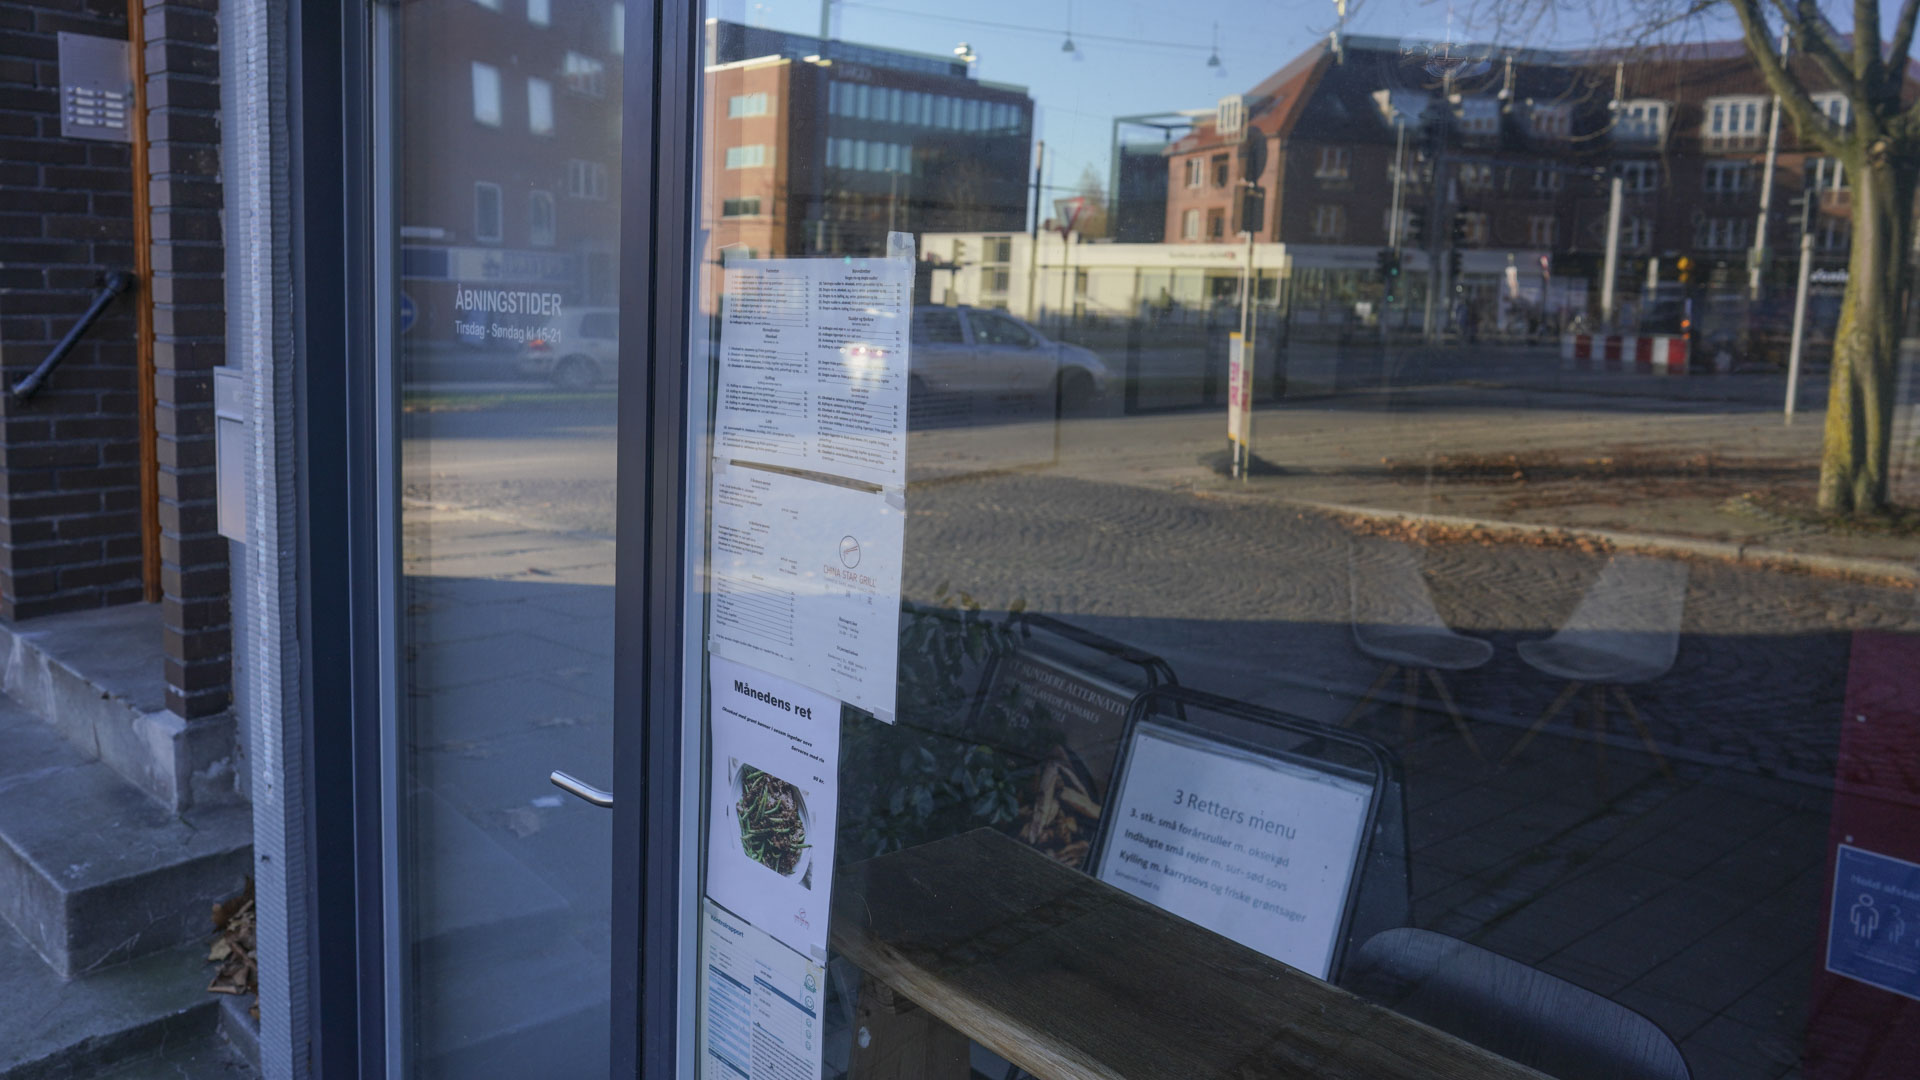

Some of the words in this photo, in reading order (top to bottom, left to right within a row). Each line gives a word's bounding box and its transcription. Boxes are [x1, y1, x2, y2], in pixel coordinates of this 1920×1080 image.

[455, 283, 562, 316] ÅBNINGSTIDER
[455, 320, 485, 340] Tirsdag
[491, 323, 524, 343] Søndag
[526, 326, 534, 339] kl
[536, 327, 561, 343] 15-21
[823, 564, 841, 577] CHINA
[842, 570, 858, 582] STAR
[859, 574, 876, 588] GRILL
[734, 680, 791, 712] Månedens
[794, 704, 812, 720] ret
[1173, 789, 1184, 805] 3
[1187, 793, 1245, 824] Retters
[1248, 815, 1296, 840] menu
[1129, 808, 1138, 818] 3.
[1140, 813, 1156, 824] stk.
[1158, 818, 1176, 830] små
[1178, 823, 1232, 849] forårsruller
[1234, 843, 1246, 854] m.
[1248, 848, 1290, 867] oksekød
[1124, 829, 1163, 850] Indbagte
[1165, 844, 1184, 856] små
[1186, 850, 1210, 864] rejer
[1211, 859, 1223, 870] m.
[1266, 878, 1288, 892] sovs
[1119, 849, 1149, 870] Kylling
[1150, 861, 1162, 873] m.
[1163, 864, 1208, 889] karrysovs
[1210, 883, 1223, 896] og
[1224, 885, 1251, 904] friske
[1252, 898, 1307, 923] grøntsager
